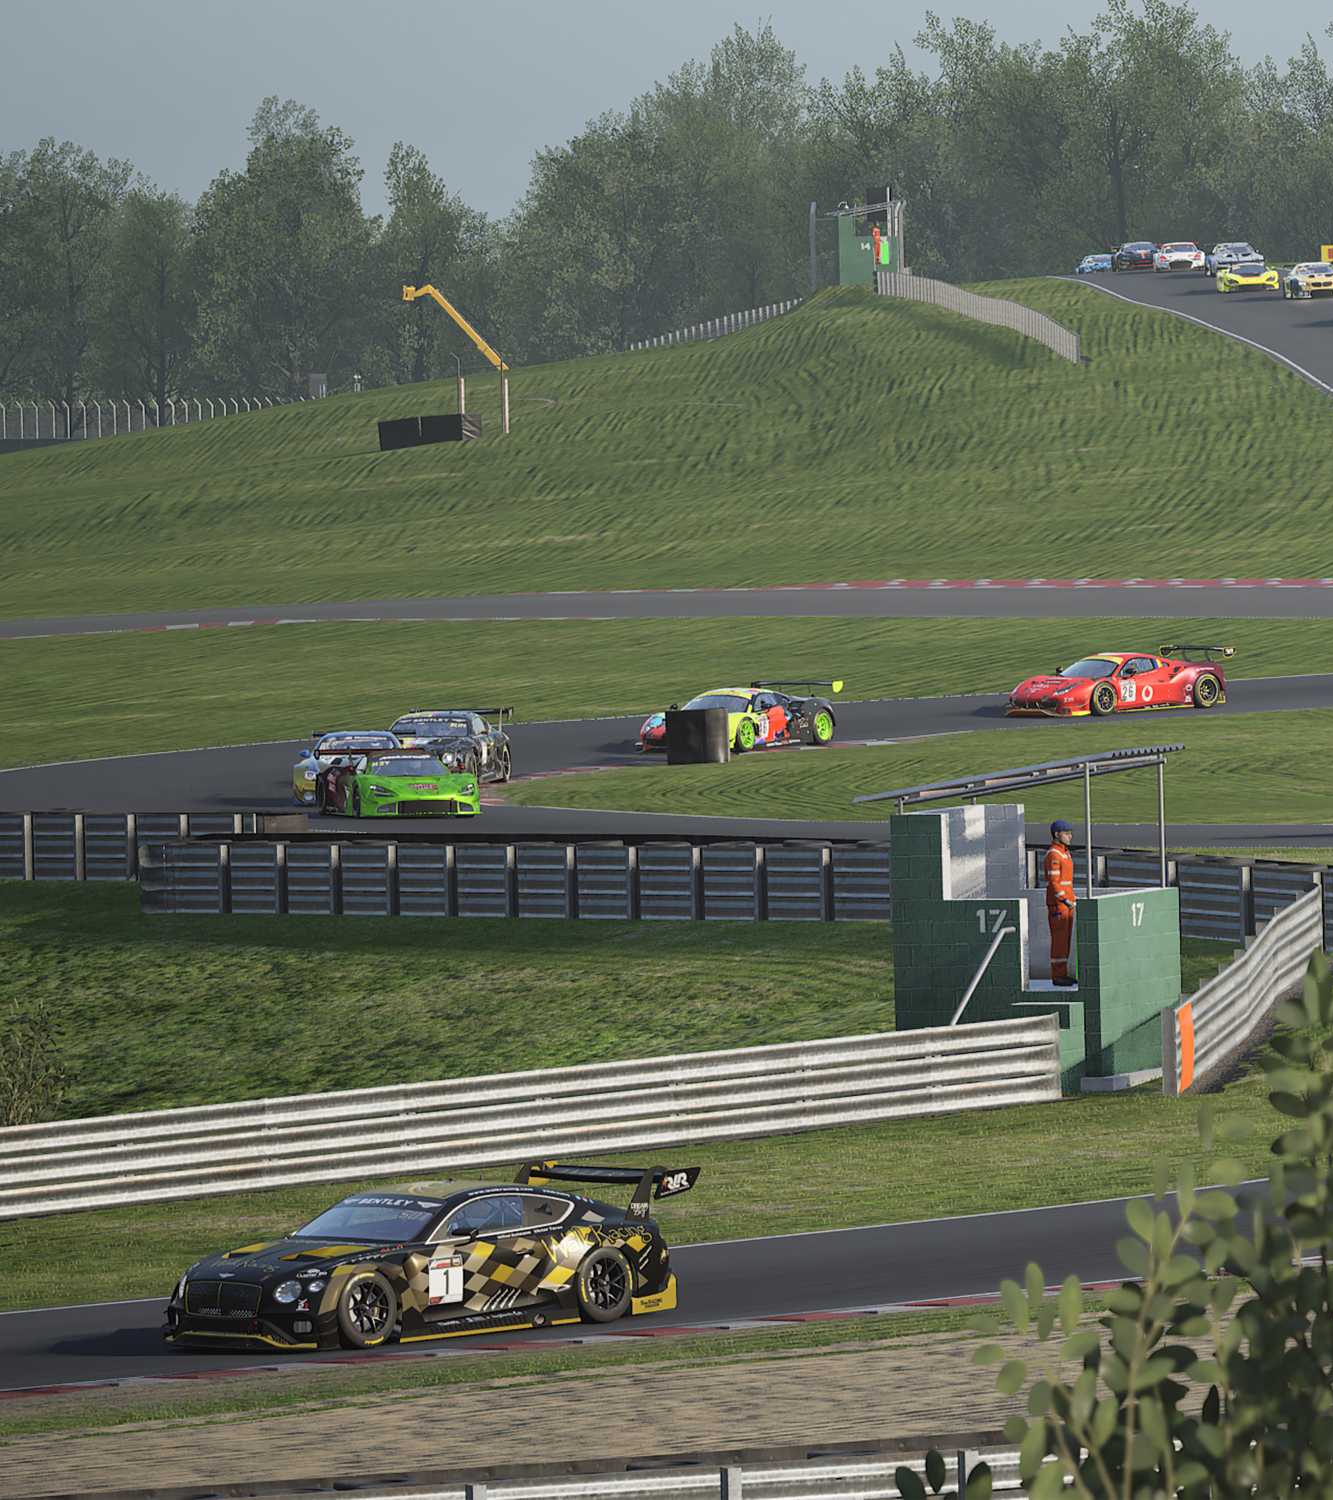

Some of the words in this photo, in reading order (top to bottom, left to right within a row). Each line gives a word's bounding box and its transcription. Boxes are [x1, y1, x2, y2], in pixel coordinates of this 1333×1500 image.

[976, 909, 1008, 933] 17
[1131, 902, 1145, 928] 17
[357, 1198, 414, 1207] BENTLEY
[590, 1223, 653, 1247] Racing
[443, 1269, 450, 1295] 1
